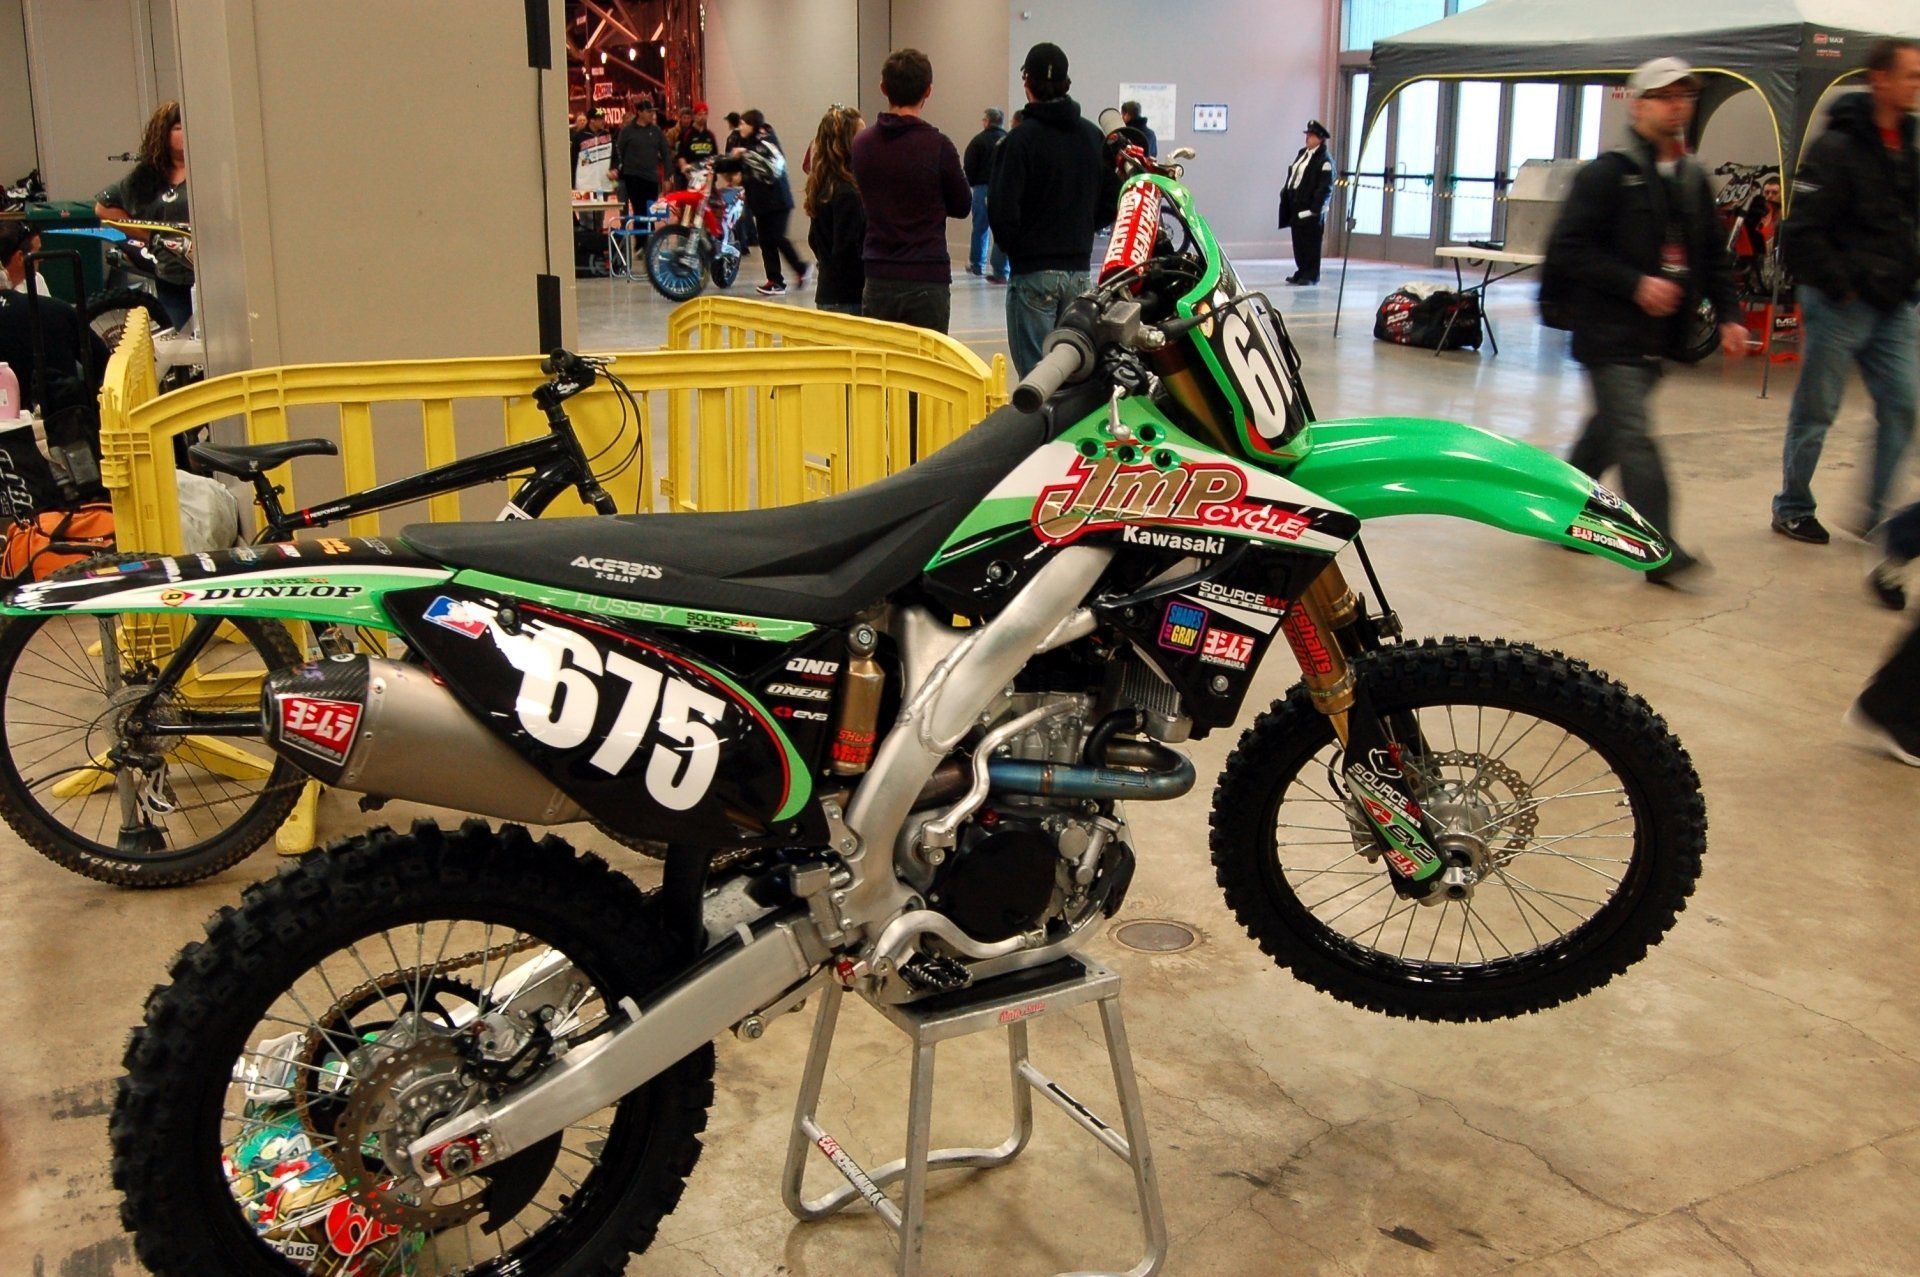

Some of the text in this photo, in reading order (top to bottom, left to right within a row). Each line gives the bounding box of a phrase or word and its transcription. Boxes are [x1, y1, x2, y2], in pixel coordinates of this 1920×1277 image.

[1130, 183, 1157, 265] RENTHAL
[1204, 505, 1304, 537] CYCLE
[1123, 525, 1225, 555] Kawasaki
[1593, 532, 1647, 558] YOSHIMURA
[595, 572, 637, 584] X-SEAT
[200, 586, 362, 601] DUNLOP
[574, 592, 673, 621] HUSSEY
[1171, 625, 1198, 647] GRAY
[286, 699, 355, 742] ヨシムラ
[516, 626, 726, 811] 675
[80, 851, 141, 871] KENDA
